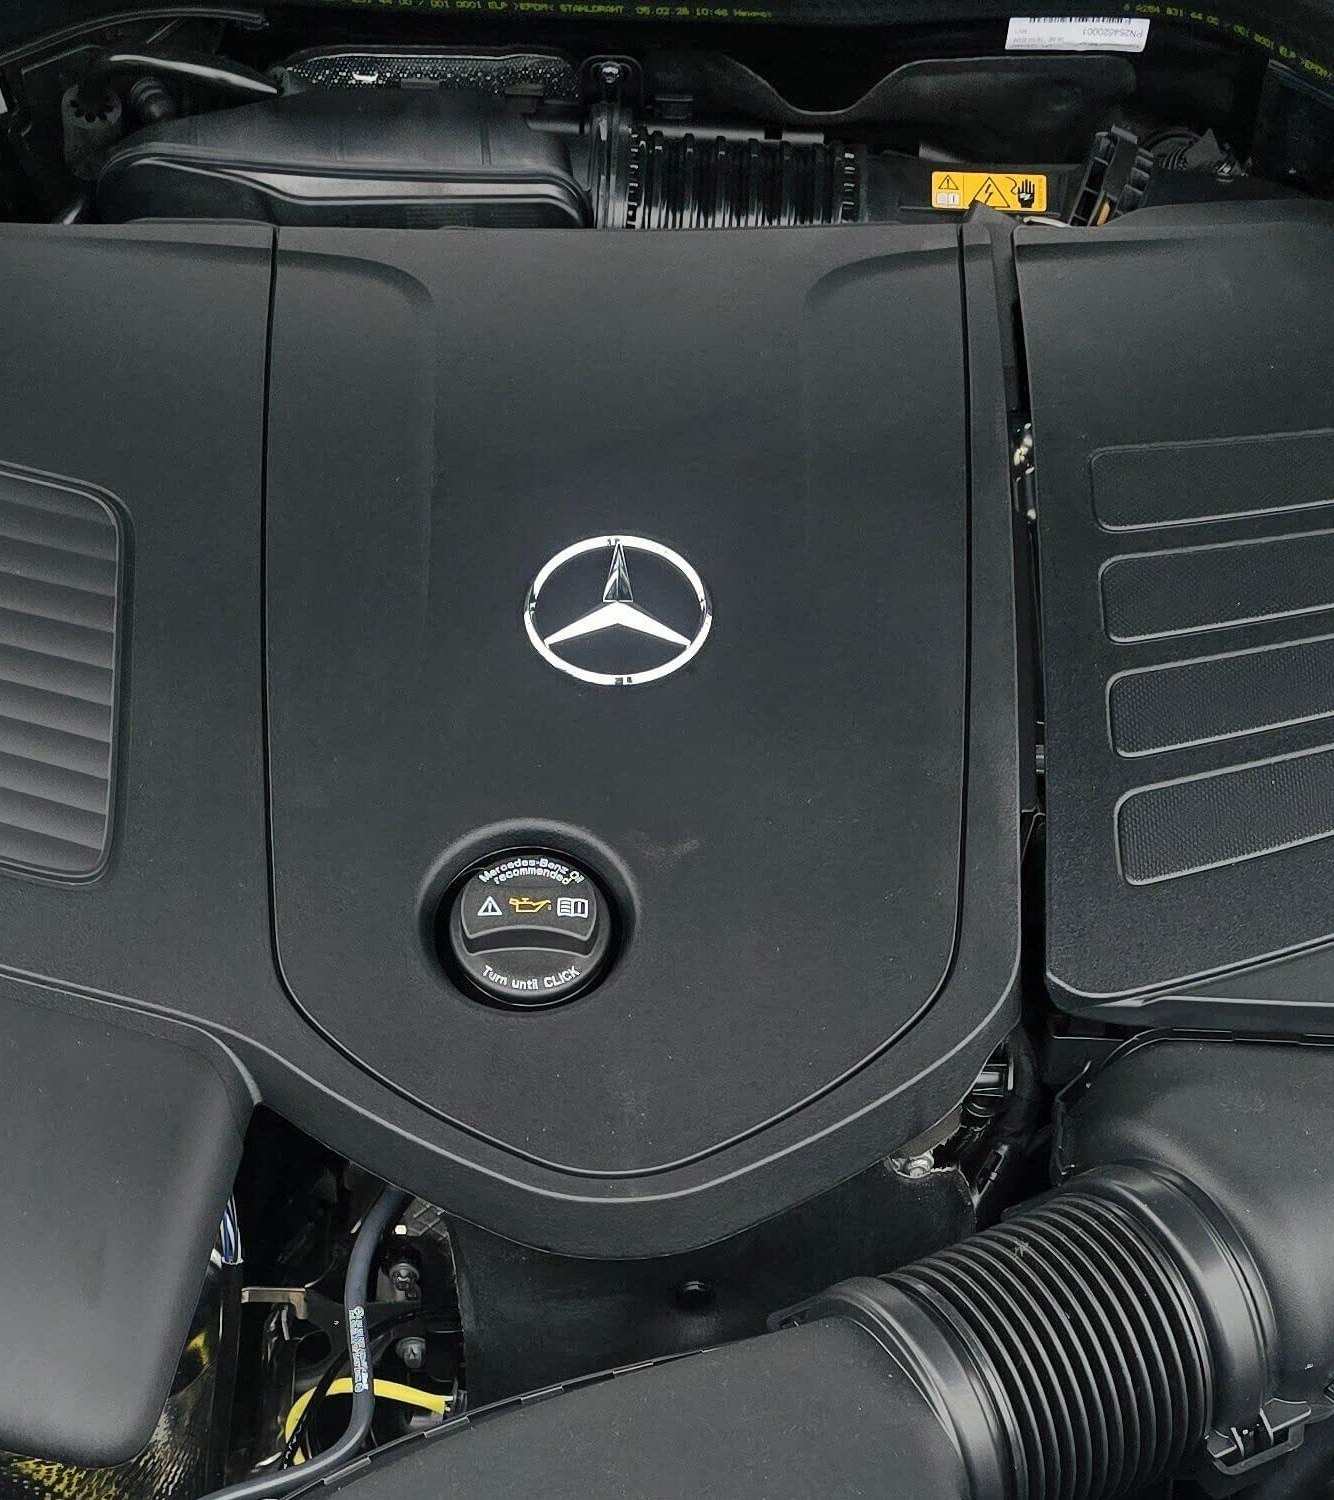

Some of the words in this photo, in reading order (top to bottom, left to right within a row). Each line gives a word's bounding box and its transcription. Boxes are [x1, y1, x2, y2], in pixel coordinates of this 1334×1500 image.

[479, 858, 570, 884] Mercedes-Benz
[569, 869, 586, 885] Oil
[493, 866, 573, 886] recommended
[482, 965, 508, 987] Turn
[511, 979, 539, 991] until
[543, 965, 582, 989] CLICK
